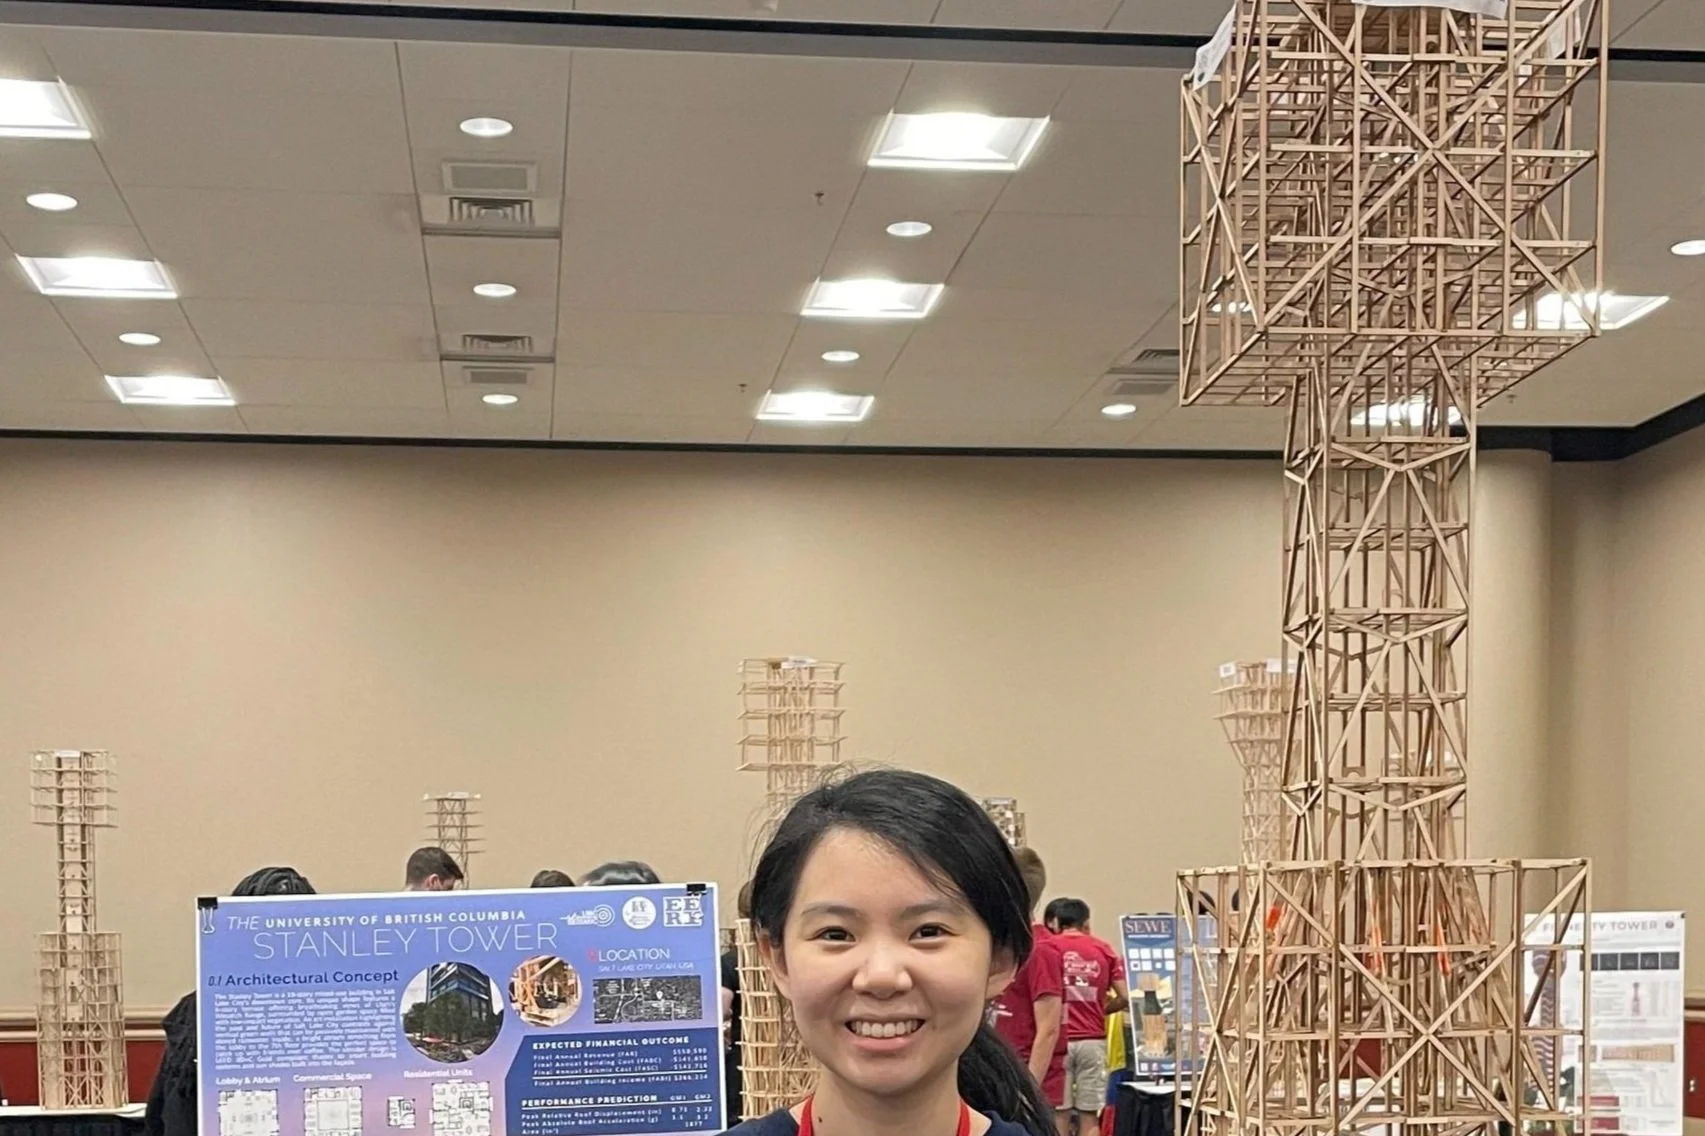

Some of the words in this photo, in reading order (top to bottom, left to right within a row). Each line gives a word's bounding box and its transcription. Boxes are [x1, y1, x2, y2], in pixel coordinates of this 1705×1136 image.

[227, 916, 259, 930] THE
[265, 915, 355, 929] UNIVERSITY
[359, 914, 378, 925] OF
[385, 912, 443, 925] BRITISH
[448, 910, 526, 922] COLUMBIA
[1611, 920, 1658, 931] TOWER
[253, 927, 417, 961] STANLEY
[427, 922, 558, 954] TOWER
[598, 947, 670, 962] LOCATION
[208, 976, 223, 987] 0.1
[225, 971, 329, 988] Architectural
[333, 969, 399, 985] Concept
[532, 1041, 583, 1050] EXPECTED
[585, 1038, 639, 1048] FINANCIAL
[641, 1036, 689, 1045] OUTCOME
[215, 1076, 243, 1085] Lobby
[252, 1075, 280, 1084] Atrium
[293, 1073, 344, 1083] Commercial
[345, 1072, 373, 1082] Space
[404, 1069, 450, 1078] Residential
[451, 1069, 473, 1077] Units
[521, 1097, 594, 1107] PERFORMANCE
[597, 1095, 658, 1104] PREDICTION
